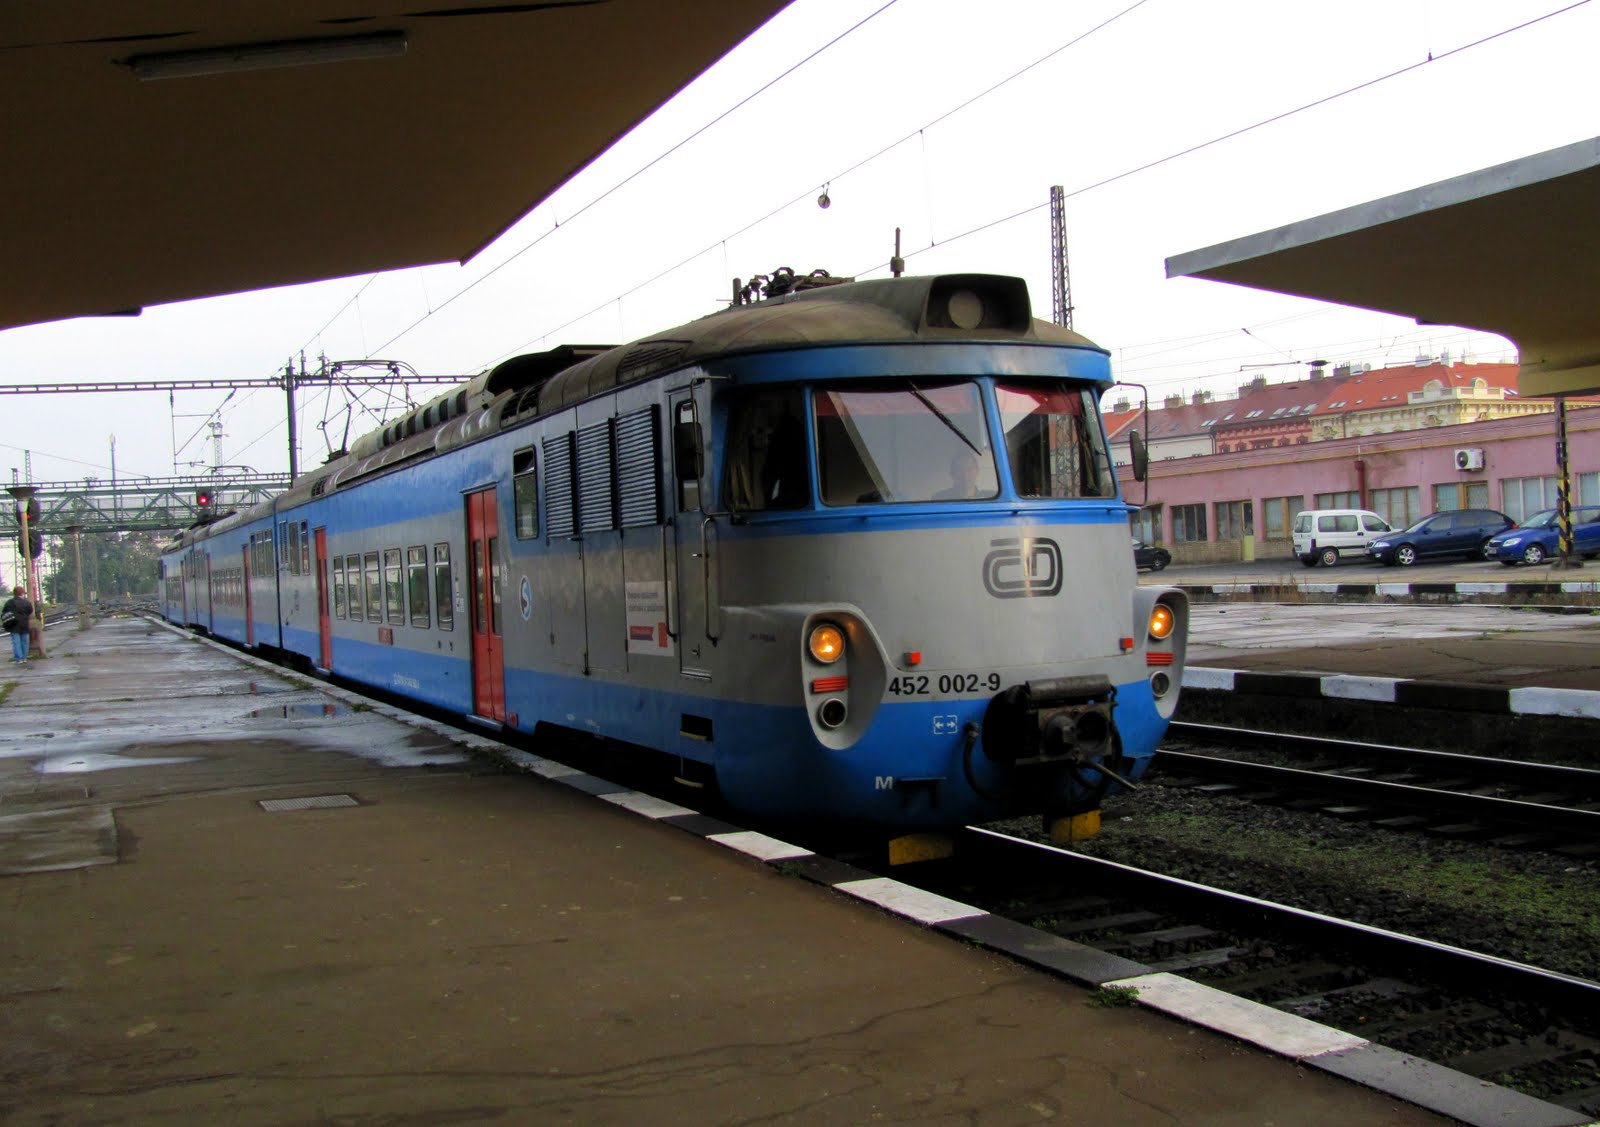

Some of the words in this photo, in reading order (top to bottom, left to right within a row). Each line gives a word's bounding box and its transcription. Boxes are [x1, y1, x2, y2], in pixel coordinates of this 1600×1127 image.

[888, 676, 929, 695] 452
[938, 672, 1001, 694] 002-9
[875, 776, 893, 789] M
